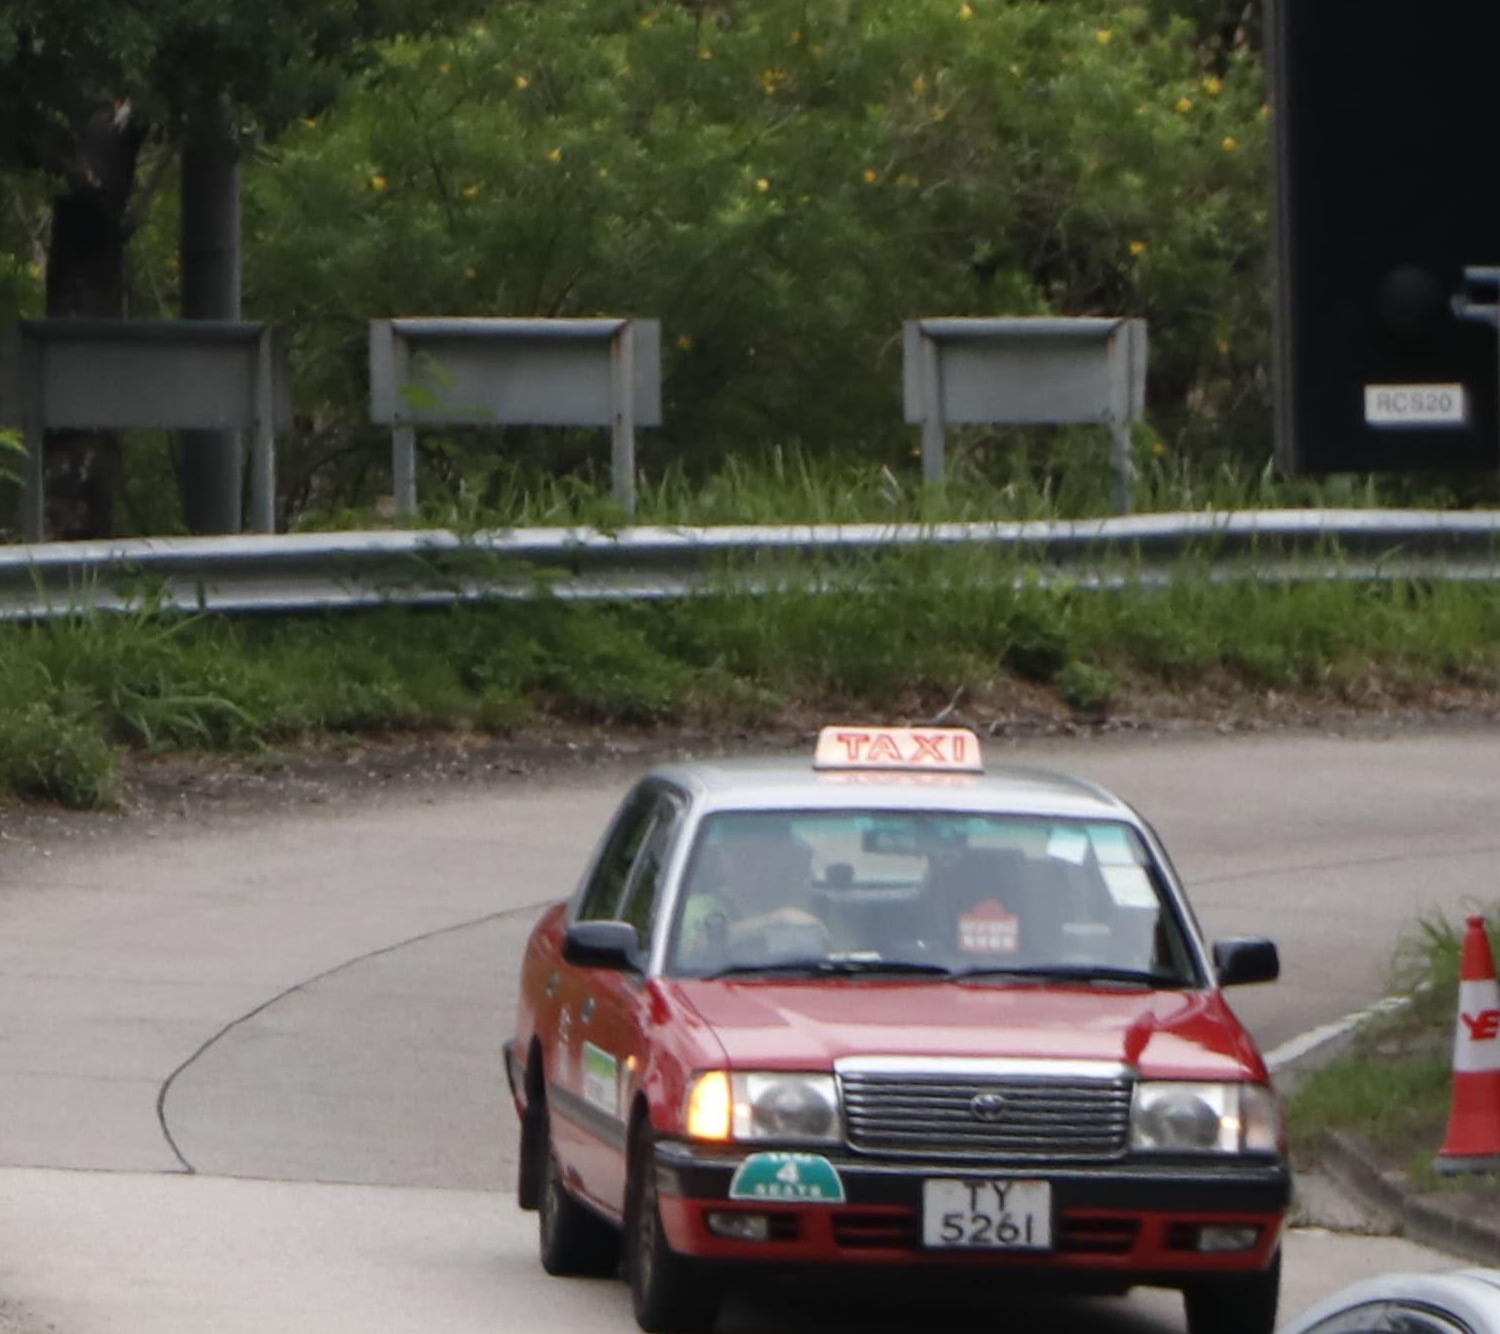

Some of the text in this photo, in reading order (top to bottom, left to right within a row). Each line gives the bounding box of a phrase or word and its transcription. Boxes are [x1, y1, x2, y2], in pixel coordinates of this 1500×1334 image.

[837, 733, 964, 763] TAXI
[963, 1180, 1013, 1211] TY
[940, 1213, 1033, 1244] 5261
